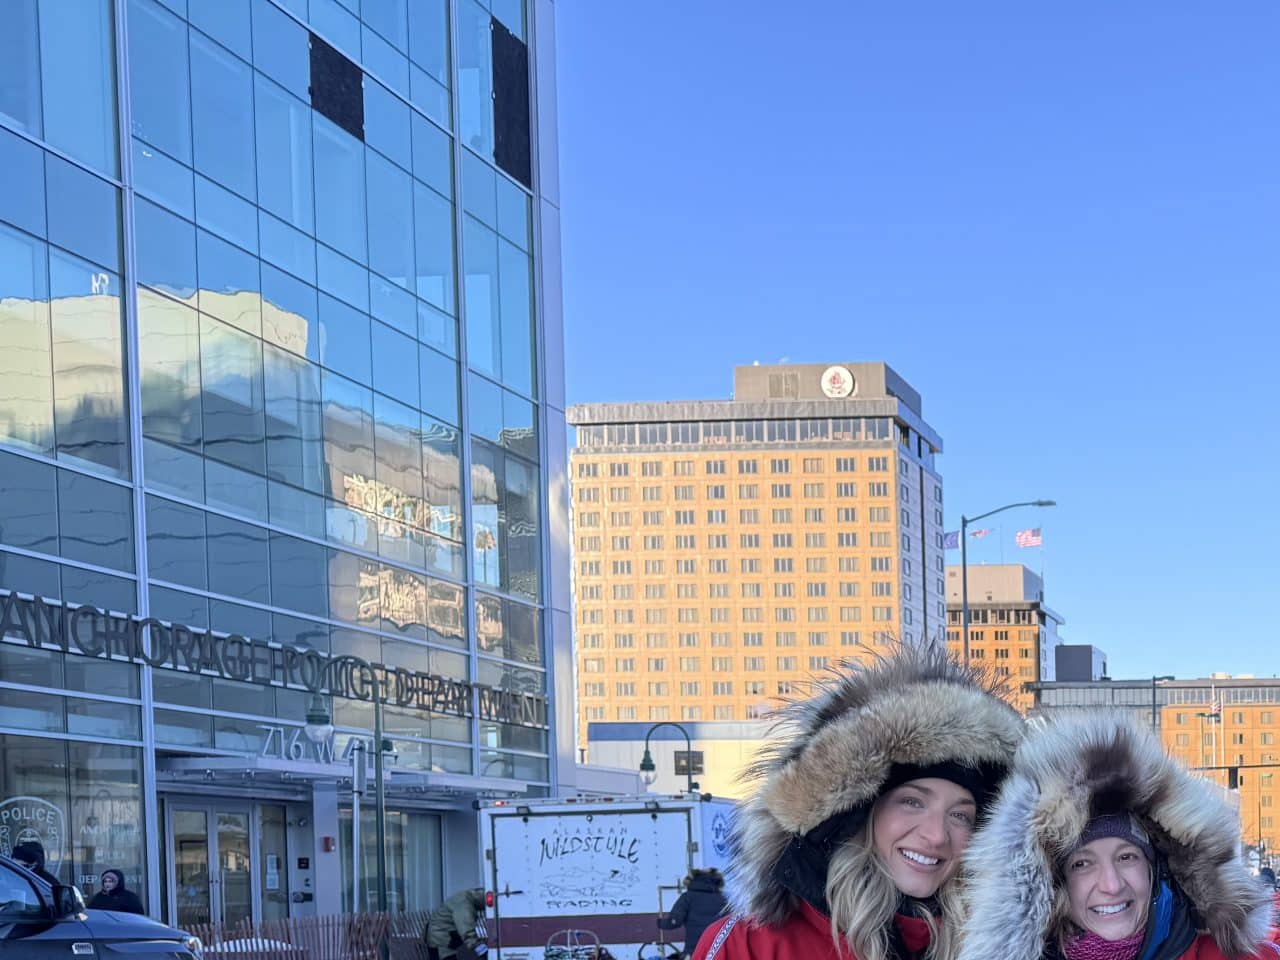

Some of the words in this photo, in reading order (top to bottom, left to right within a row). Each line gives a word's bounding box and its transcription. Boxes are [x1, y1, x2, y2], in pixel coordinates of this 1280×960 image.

[1, 591, 271, 685] ANCHORAGE
[255, 725, 304, 761] 716
[1, 807, 57, 823] POLICE
